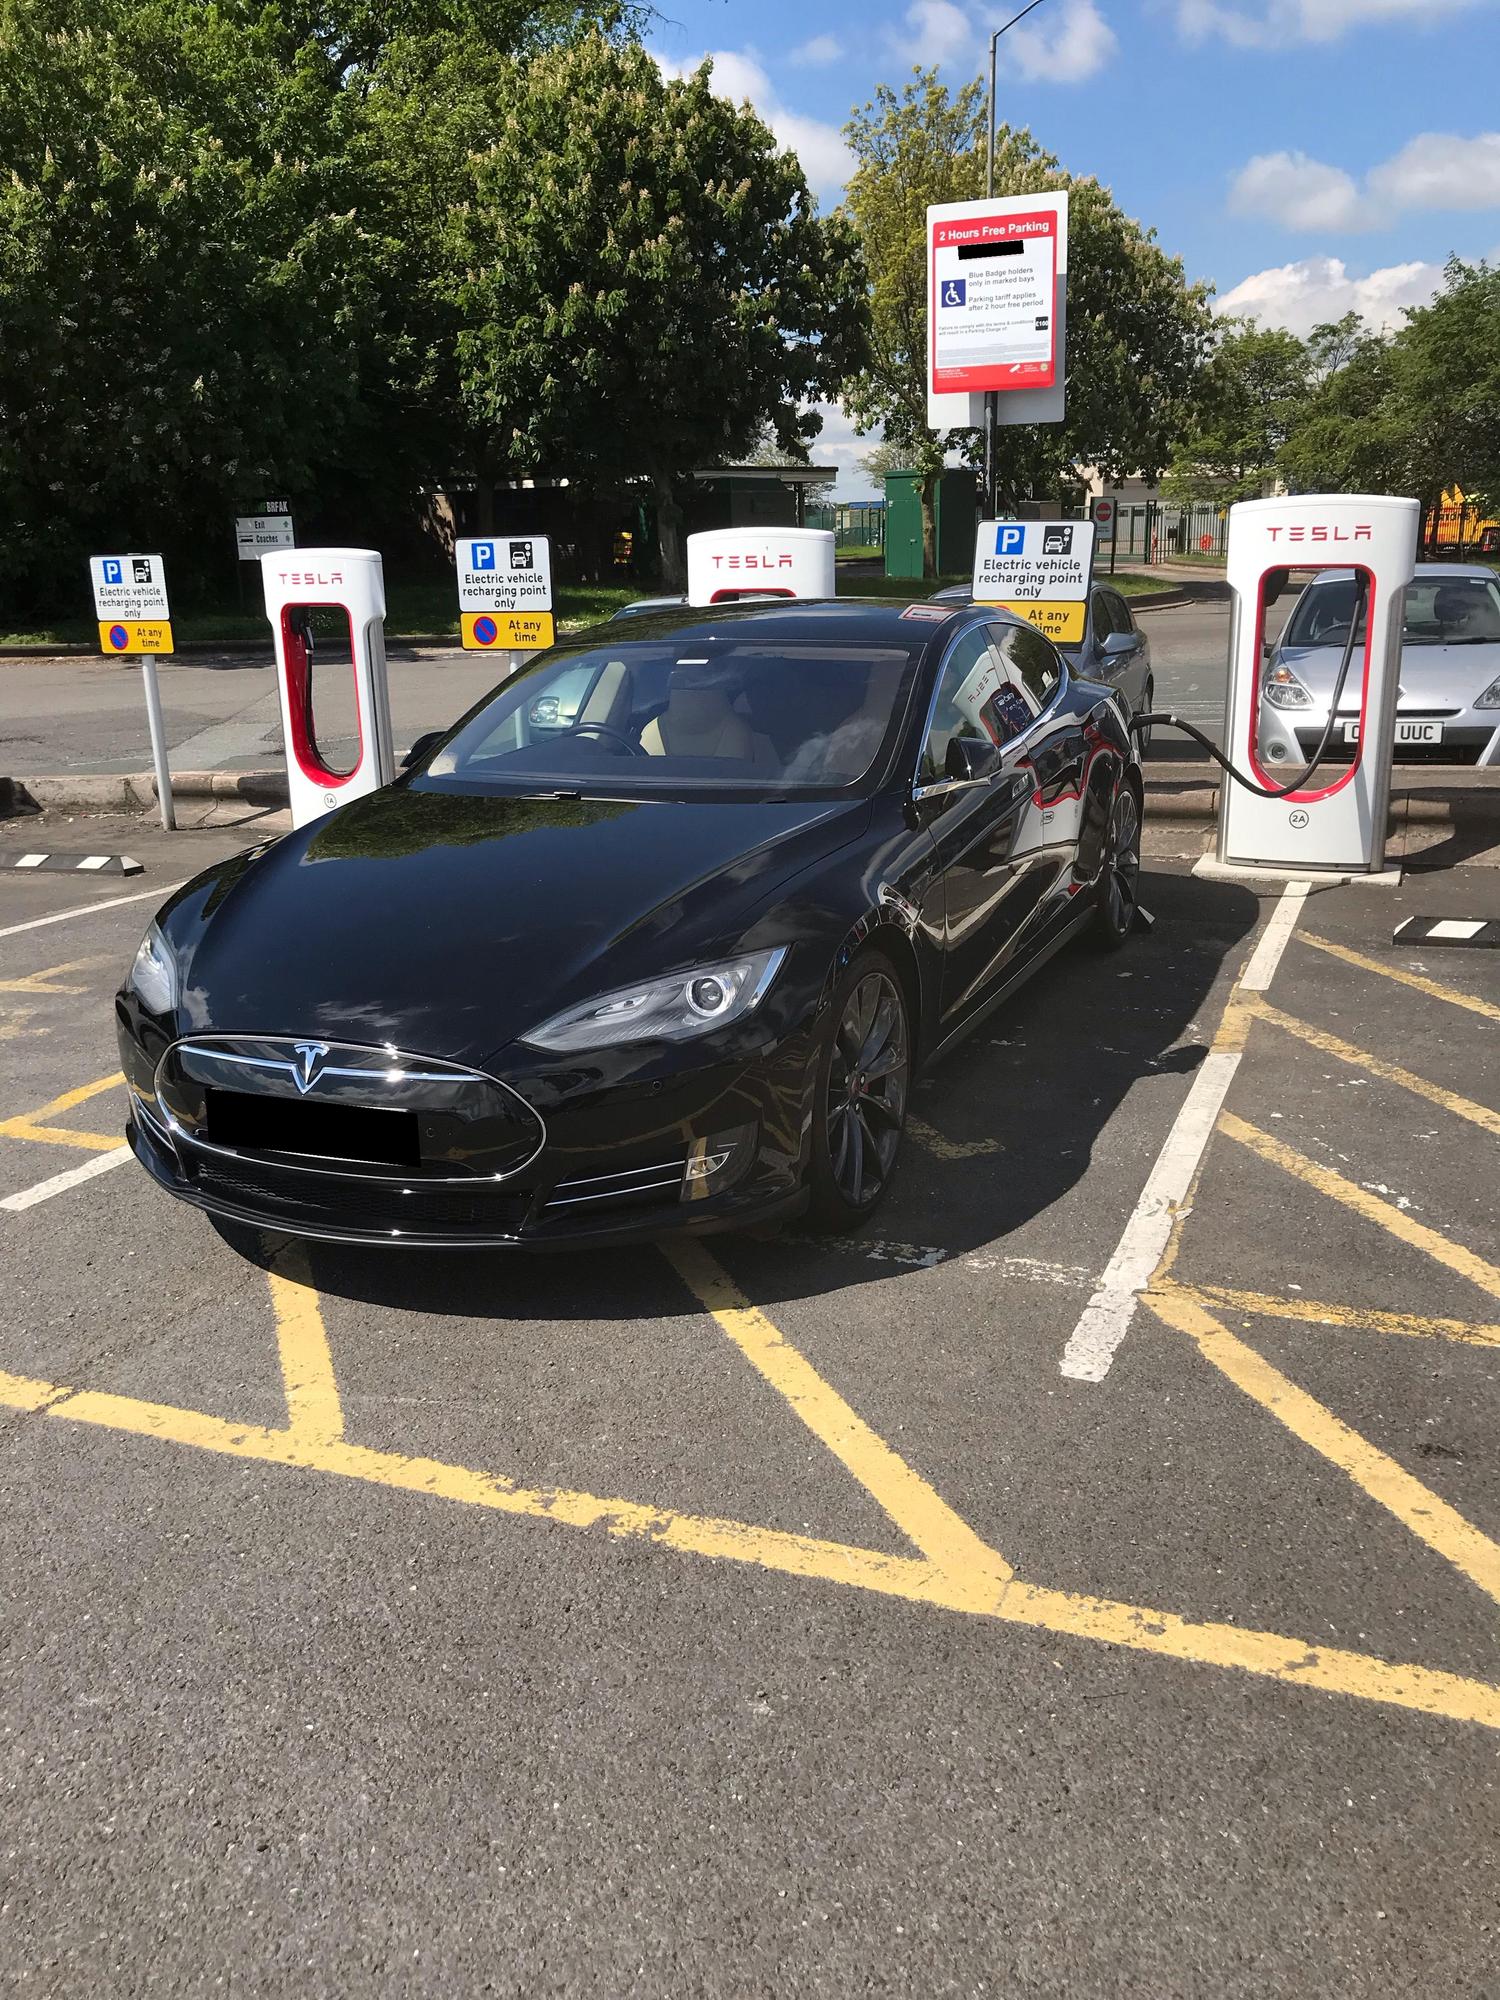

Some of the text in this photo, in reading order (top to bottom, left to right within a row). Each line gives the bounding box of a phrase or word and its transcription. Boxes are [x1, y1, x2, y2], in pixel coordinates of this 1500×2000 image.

[939, 221, 1049, 241] 2 Hours Free Parking
[985, 270, 1007, 278] Badge
[1008, 267, 1034, 276] holders
[992, 277, 1018, 285] marked
[1018, 276, 1035, 284] bays
[968, 292, 1037, 304] Parking tariff applies
[990, 302, 1006, 310] hour
[1007, 301, 1021, 309] free
[1021, 299, 1044, 308] period
[254, 520, 265, 529] Exit
[256, 534, 279, 543] Coaches
[1266, 525, 1373, 542] TESLA
[1001, 529, 1020, 553] P
[476, 546, 491, 568] P
[712, 555, 792, 569] TESLA
[983, 559, 1081, 570] Electric vehicle
[106, 562, 119, 583] P
[465, 573, 543, 584] Electric vehicle
[978, 572, 1083, 585] recharging point
[278, 573, 343, 585] TESLA
[100, 587, 161, 597] Electric vehicle
[462, 585, 547, 598] recharging point
[1014, 586, 1042, 598] only
[98, 598, 165, 608] recharging point
[494, 598, 516, 610] only
[124, 609, 142, 618] only
[1028, 609, 1070, 622] At any
[508, 620, 541, 632] At any
[137, 628, 162, 638] At any
[514, 632, 537, 642] time
[142, 639, 160, 648] time
[1400, 725, 1434, 740] UUC
[1292, 814, 1306, 823] 2A
